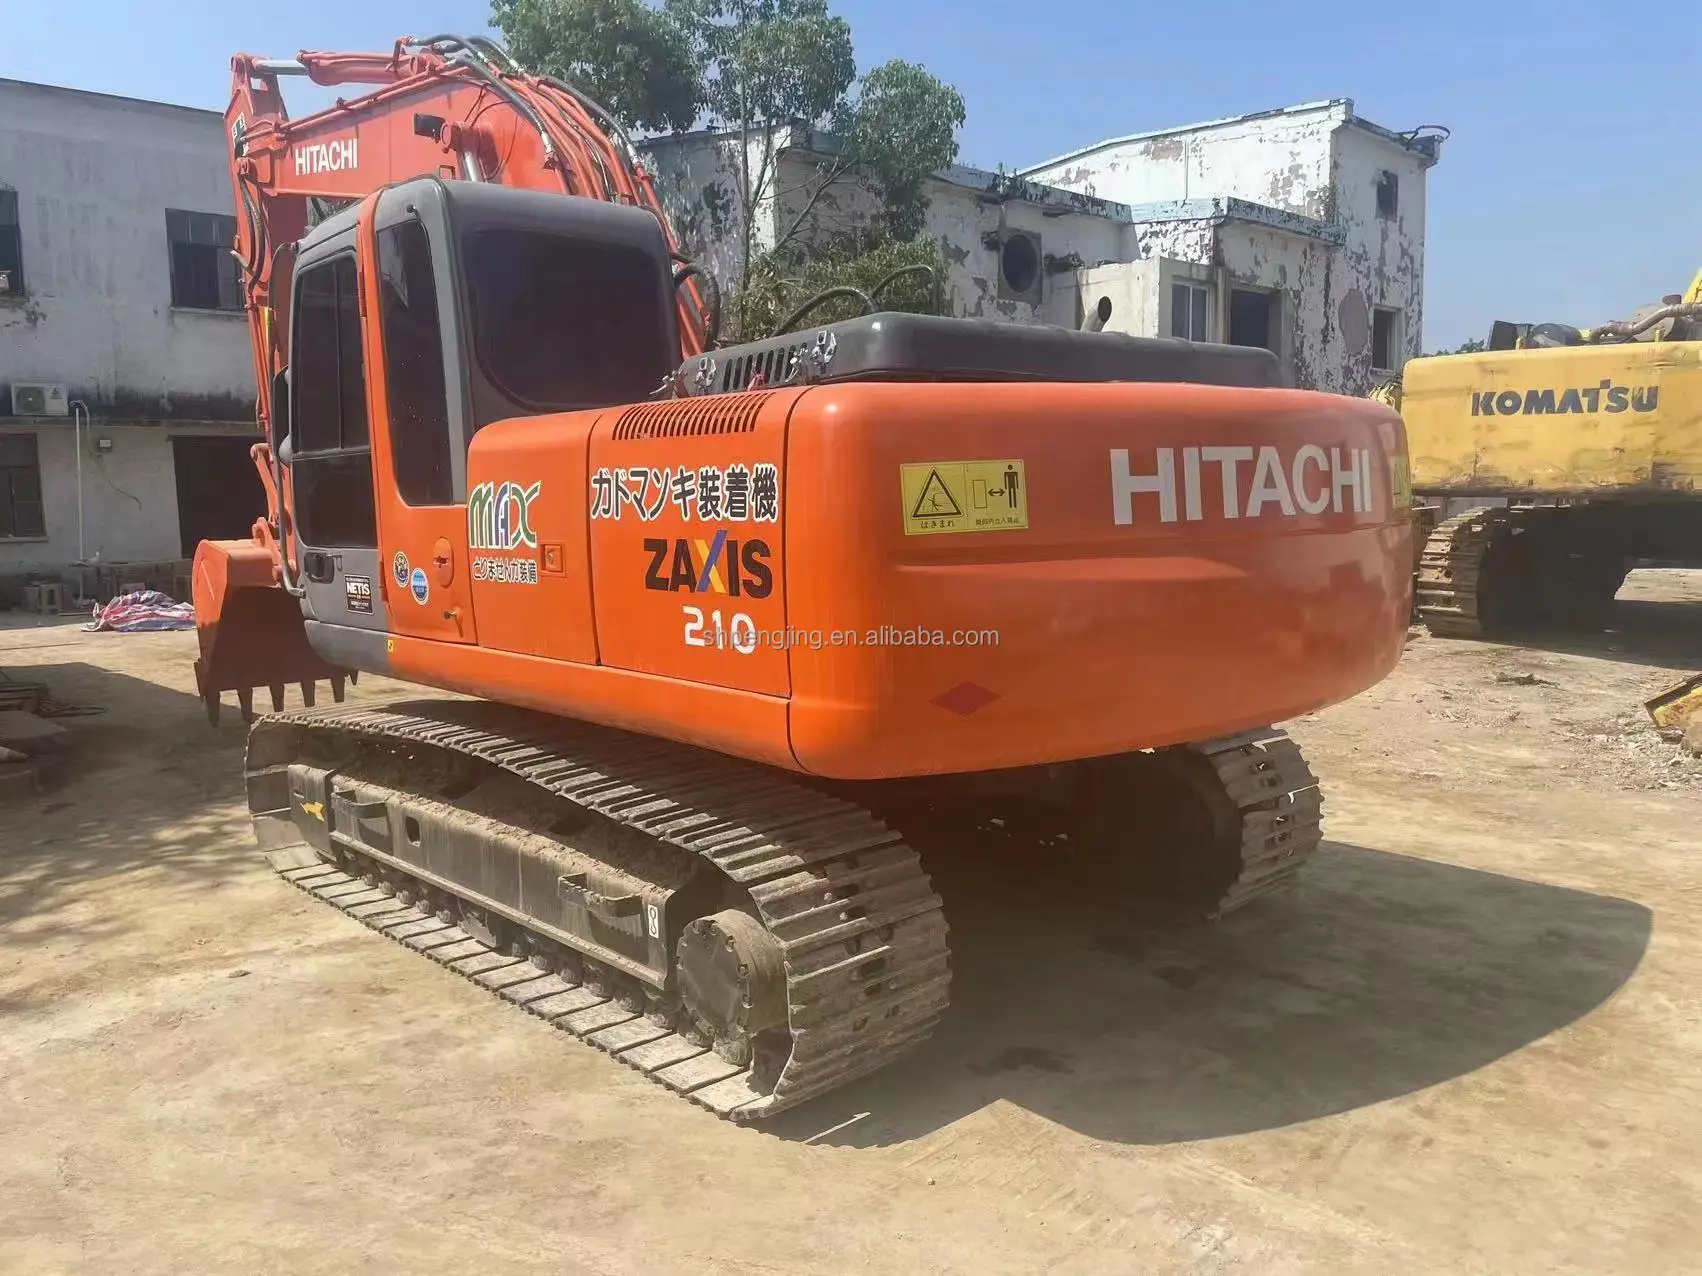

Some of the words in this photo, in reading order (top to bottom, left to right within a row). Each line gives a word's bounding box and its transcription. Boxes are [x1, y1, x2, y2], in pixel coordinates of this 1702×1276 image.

[295, 138, 358, 176] HITACHI
[1471, 379, 1659, 416] KOMATSU
[1110, 445, 1373, 526] HITACHI
[469, 480, 542, 550] MAX
[346, 582, 370, 595] NETIS
[643, 529, 773, 599] ZAXIS
[682, 604, 757, 655] 210
